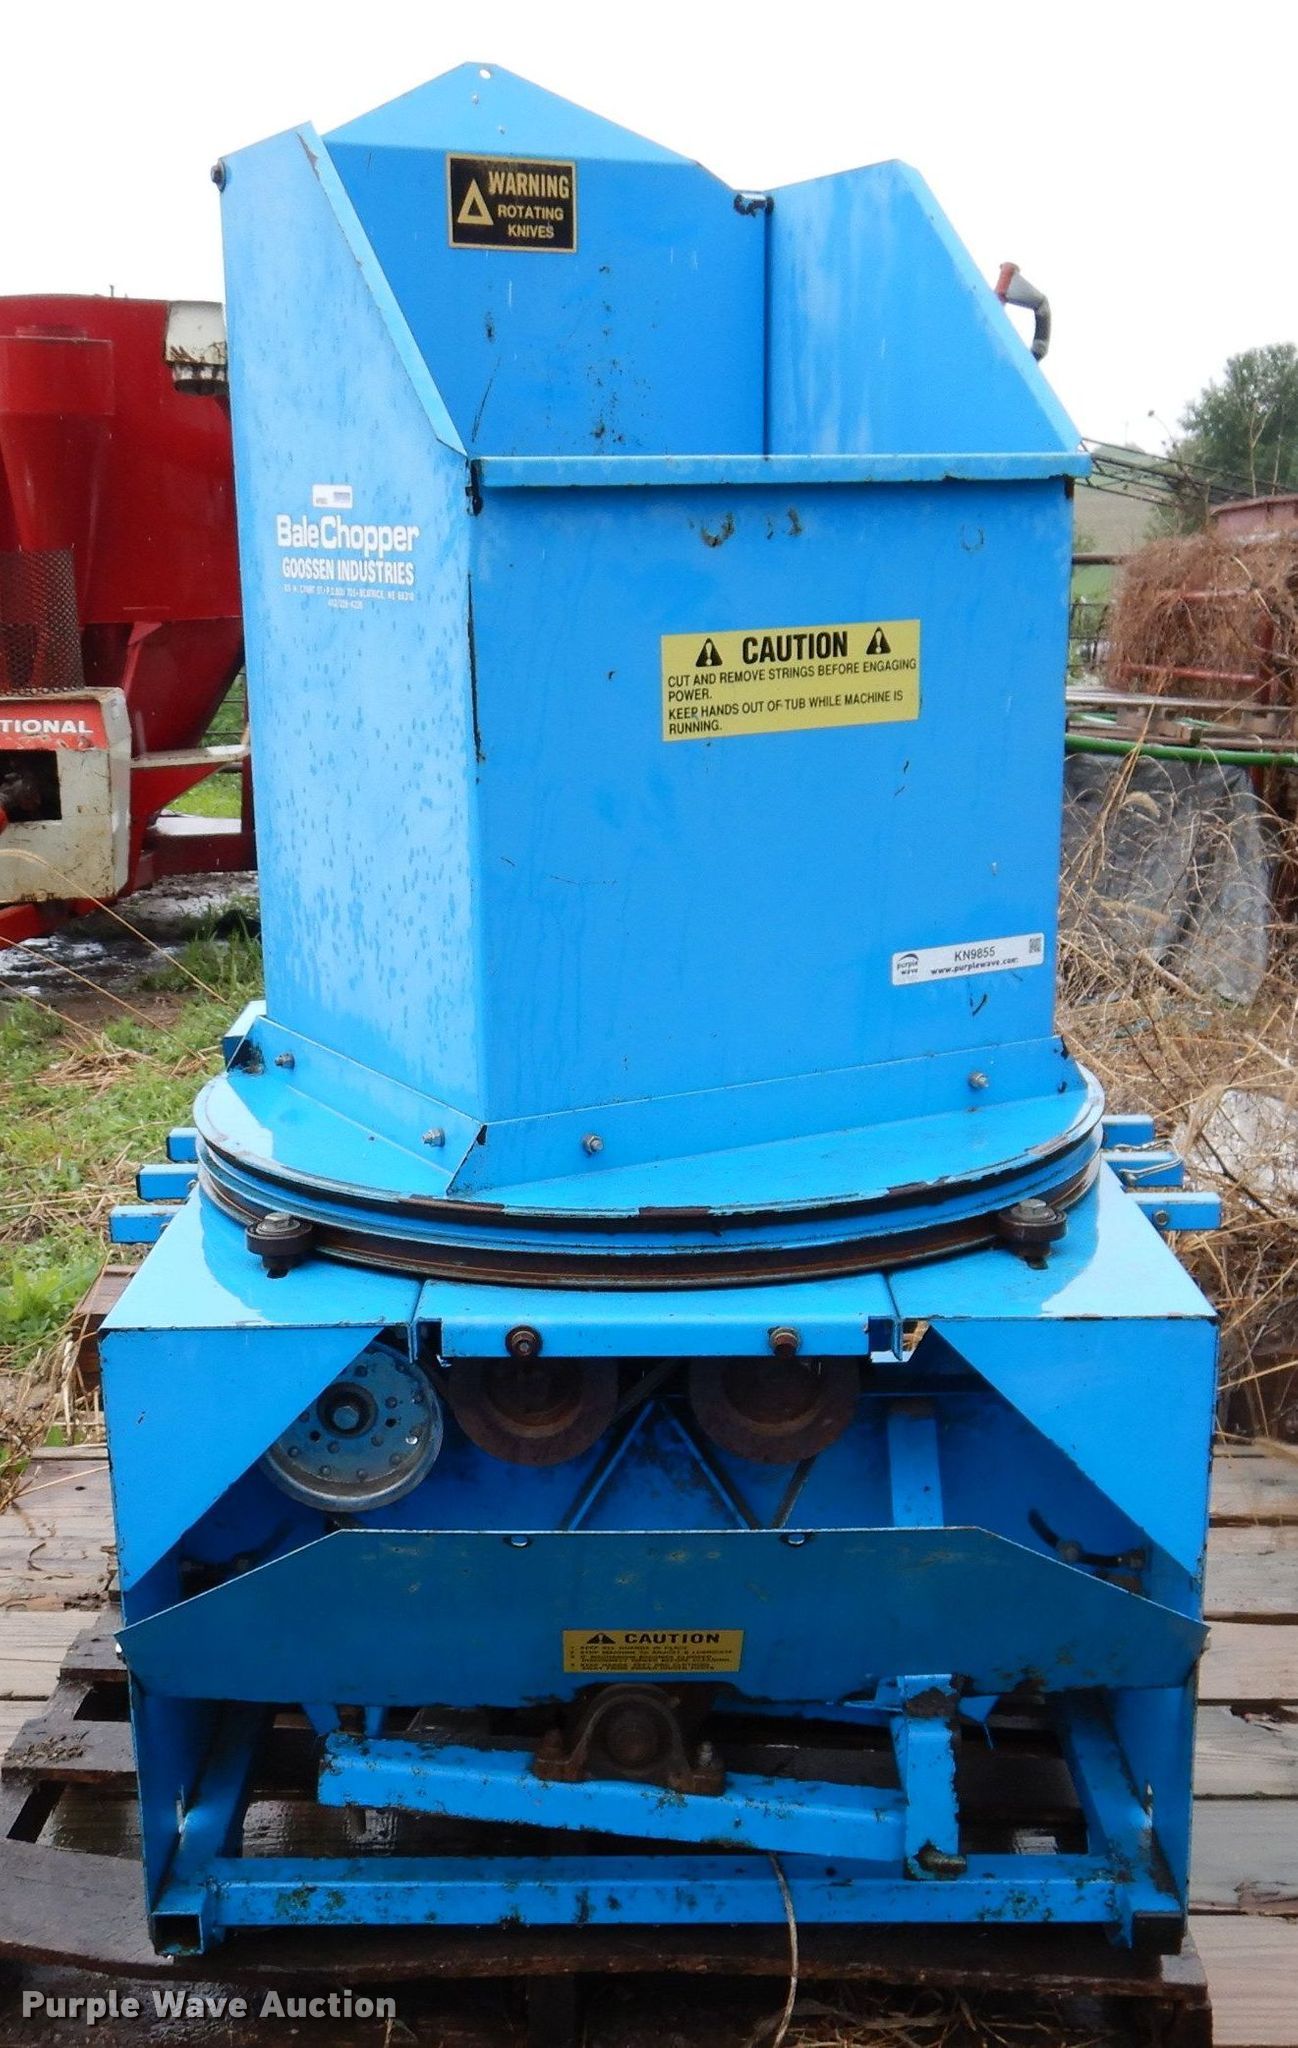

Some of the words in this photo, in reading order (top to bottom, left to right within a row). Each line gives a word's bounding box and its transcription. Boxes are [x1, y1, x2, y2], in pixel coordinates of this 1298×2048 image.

[488, 171, 570, 199] WARNING
[497, 204, 564, 221] ROTATING
[507, 224, 555, 239] KNIVES
[282, 557, 334, 581] GOOSSEN
[337, 559, 415, 586] INDUSTRIES
[742, 631, 848, 665] CAUTION
[668, 674, 691, 688] CUT
[693, 672, 716, 686] AND
[719, 669, 766, 684] REMOVE
[768, 665, 815, 680] STRINGS
[817, 662, 860, 677] BEFORE
[863, 658, 917, 673] ENGAGING
[668, 688, 712, 702] POWER.
[668, 707, 698, 720] KEEP
[700, 703, 739, 718] HANDS
[742, 701, 764, 714] OUT
[767, 699, 782, 712] OF
[784, 697, 807, 711] TUB
[809, 694, 842, 708] WHILE
[844, 691, 891, 706] MACHINE
[893, 690, 904, 702] IS
[0, 719, 94, 734] TIONAL
[669, 719, 722, 735] RUNNING.
[954, 946, 996, 962] KN9855
[624, 1633, 721, 1645] CAUTION
